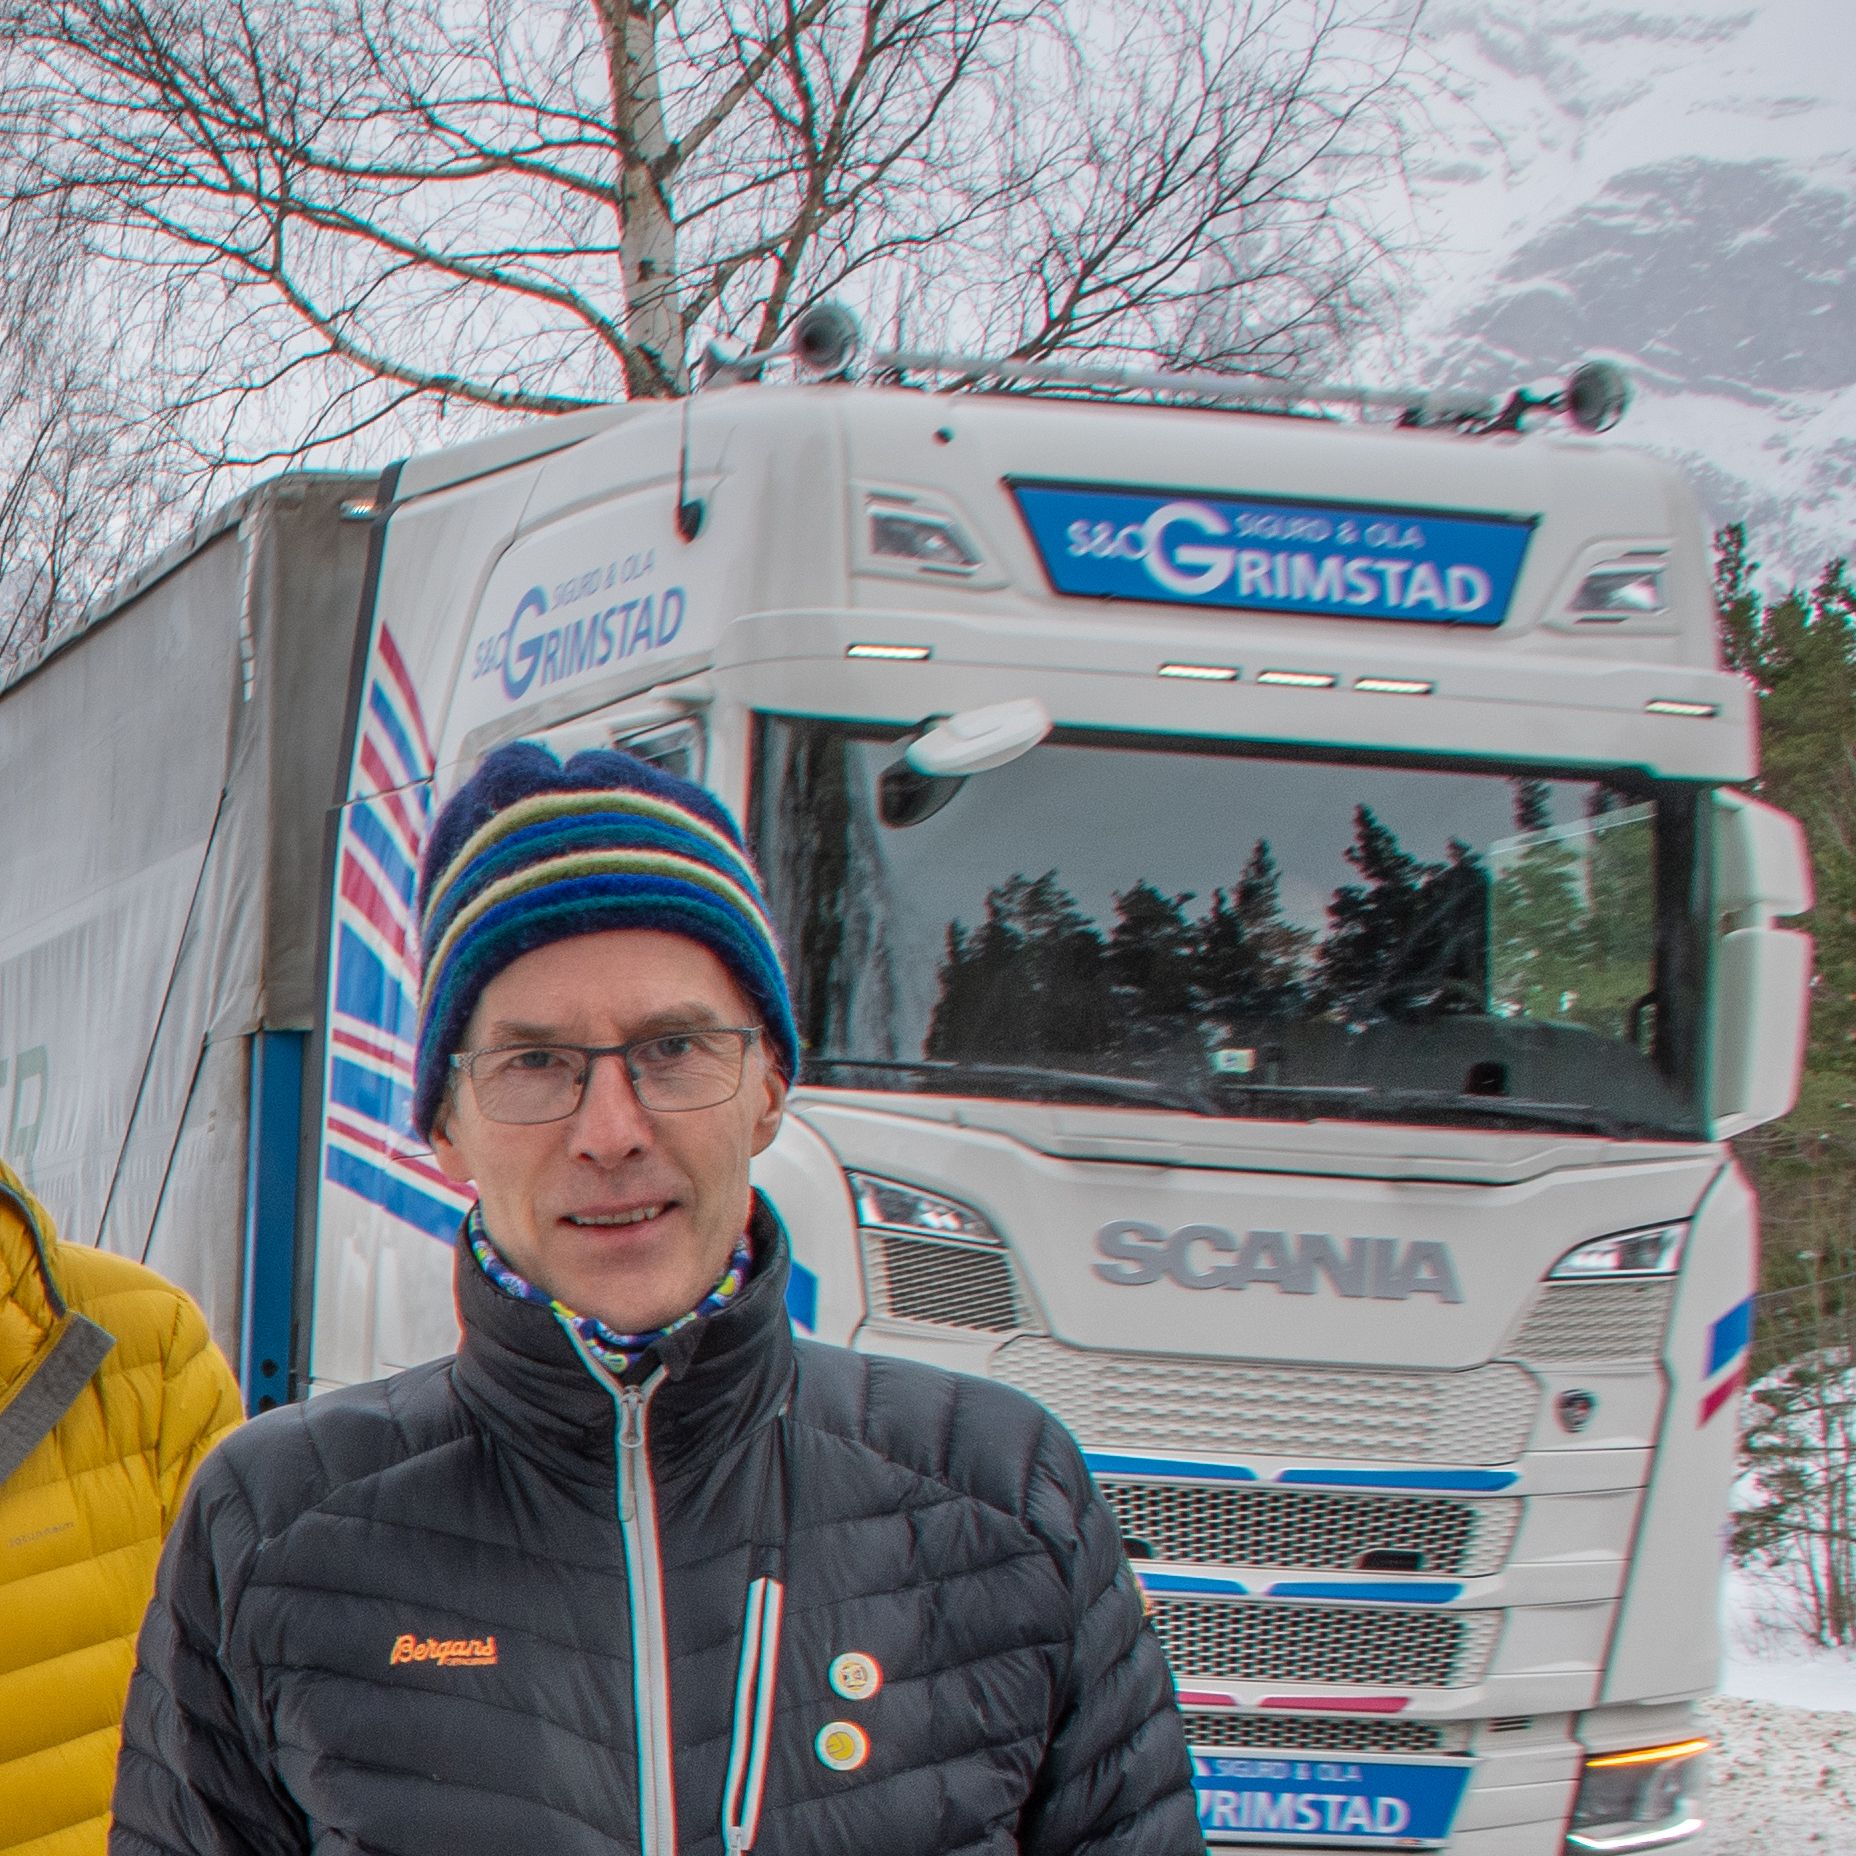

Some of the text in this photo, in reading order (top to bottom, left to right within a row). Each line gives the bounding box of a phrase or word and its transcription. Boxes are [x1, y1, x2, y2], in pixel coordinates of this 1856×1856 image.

[1143, 499, 1492, 613] GRIMSTAD
[1335, 519, 1361, 546] &
[1364, 522, 1426, 551] OLA
[502, 584, 686, 701] GRIMSTAD
[1089, 1218, 1466, 1305] SCANIA
[389, 1632, 496, 1666] Bergans
